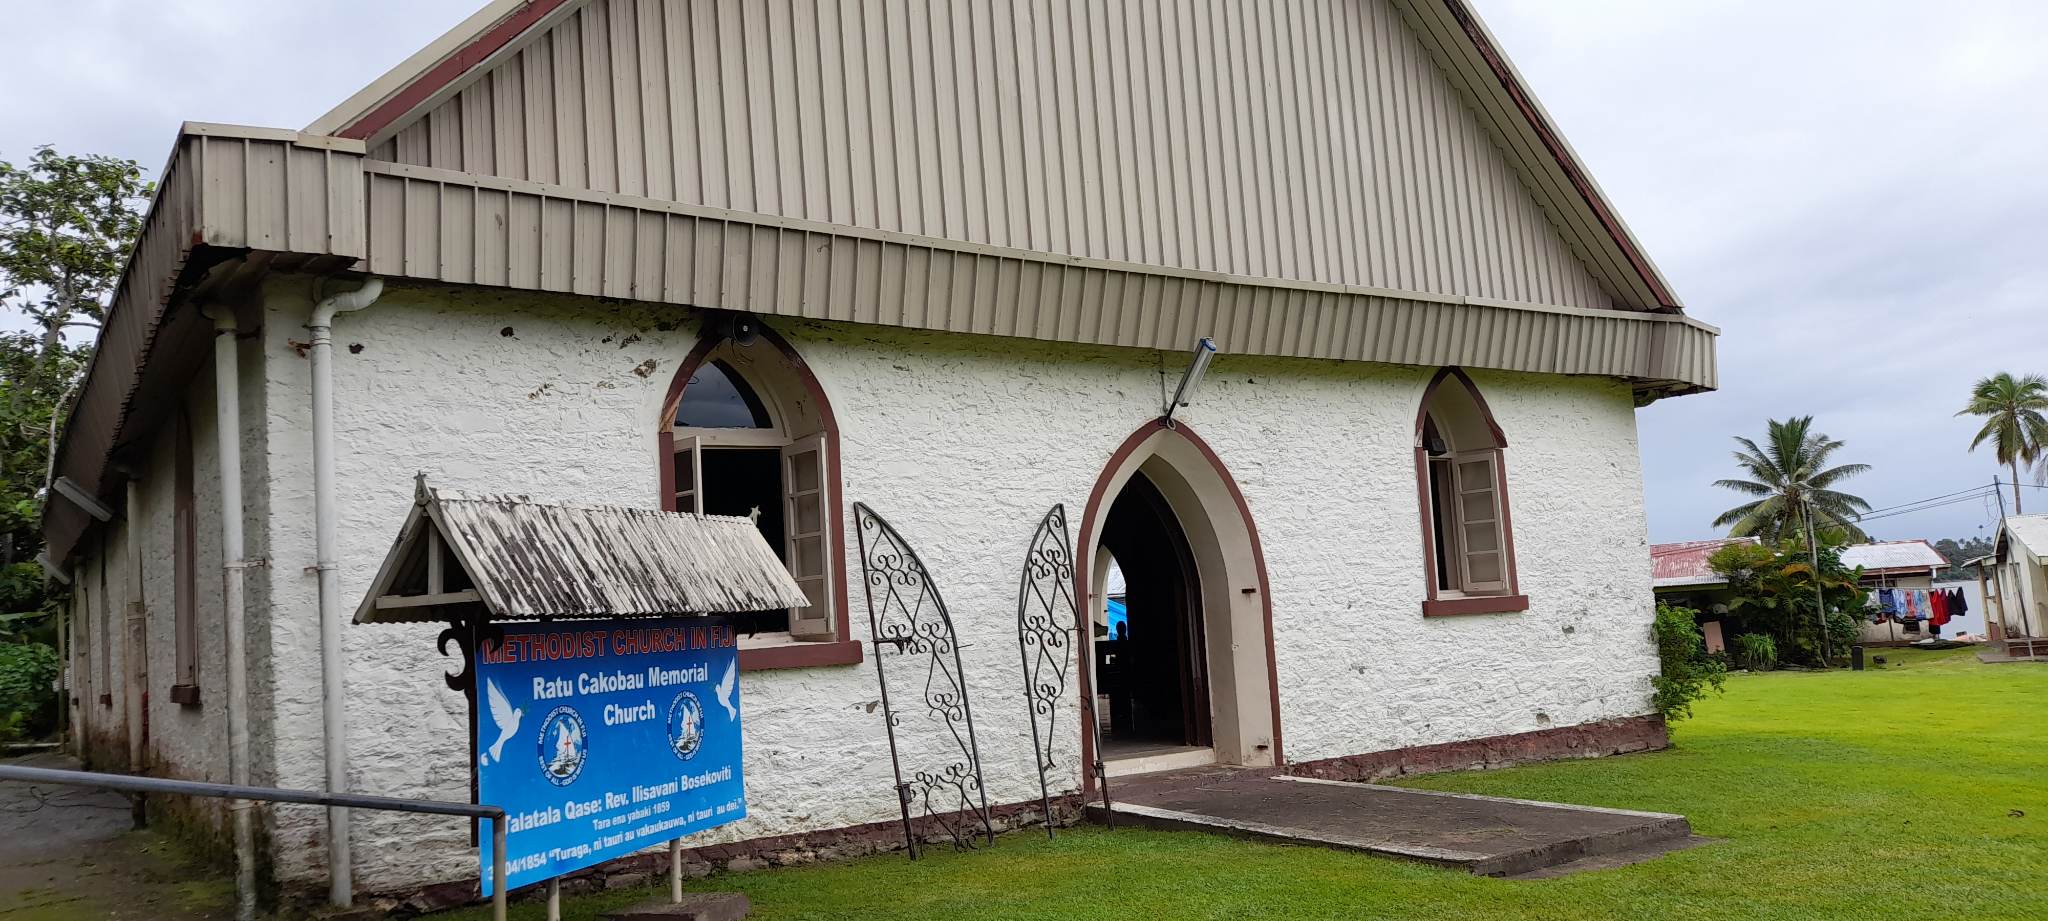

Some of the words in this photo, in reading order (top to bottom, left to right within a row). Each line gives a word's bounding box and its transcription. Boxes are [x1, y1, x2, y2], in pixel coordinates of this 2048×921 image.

[482, 631, 608, 664] METHODIST
[612, 627, 686, 655] CHURCH
[690, 626, 707, 649] IN
[710, 625, 736, 649] FIJI
[533, 676, 573, 700] Ratu
[578, 671, 644, 695] Cakobau
[648, 662, 708, 687] Memorial
[603, 700, 656, 726] Church
[505, 806, 560, 834] Talatala
[565, 800, 602, 820] Qase:
[605, 792, 629, 810] Rev.
[632, 777, 679, 803] Ilisavani
[681, 765, 732, 791] Bosekoviti
[593, 816, 610, 831] Tara
[612, 814, 626, 827] ena
[627, 807, 651, 824] yabaki
[653, 800, 670, 815] 1859
[593, 836, 602, 851] ni
[603, 831, 623, 848] tauri
[625, 829, 635, 841] au
[636, 815, 687, 837] vakaukauwa,
[688, 810, 695, 823] ni
[696, 805, 713, 820] tauri
[716, 804, 726, 815] au
